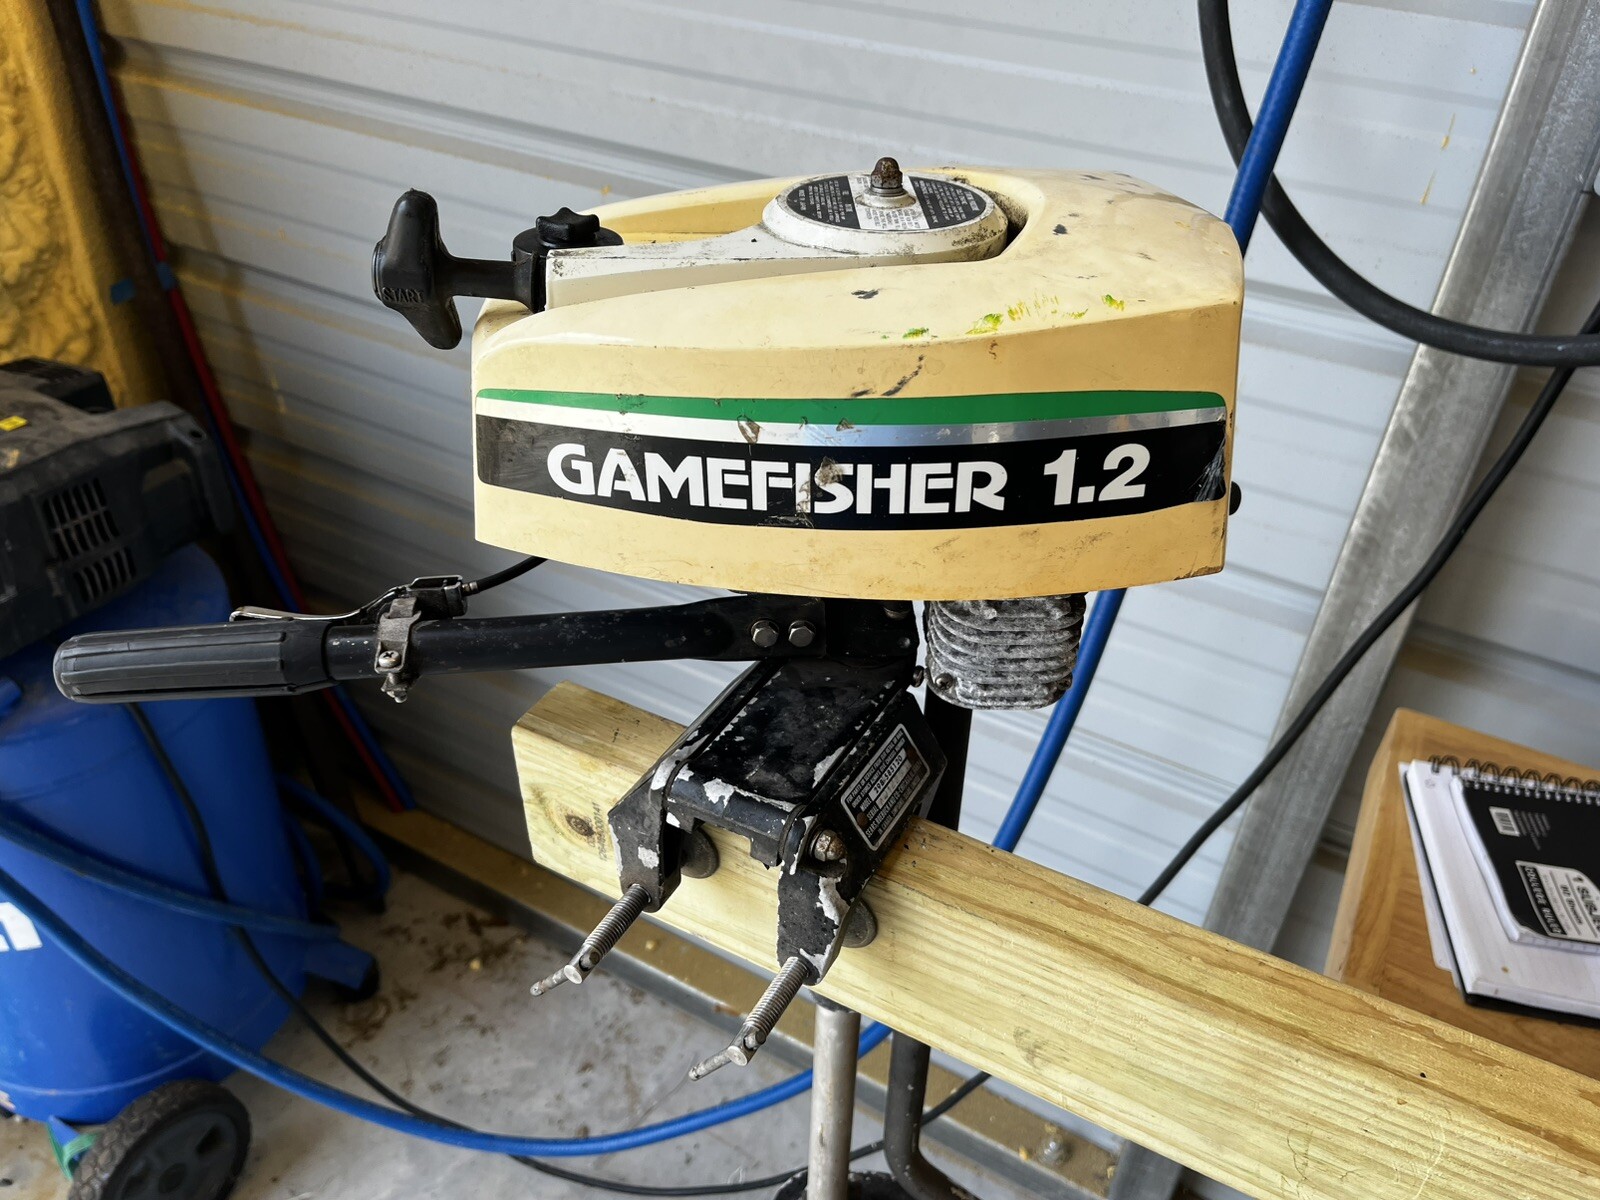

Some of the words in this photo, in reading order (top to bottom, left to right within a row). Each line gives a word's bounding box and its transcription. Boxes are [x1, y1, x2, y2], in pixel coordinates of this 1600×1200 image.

[382, 286, 424, 304] START
[547, 443, 1008, 515] GAMEFISHER
[1043, 443, 1151, 506] 1.2
